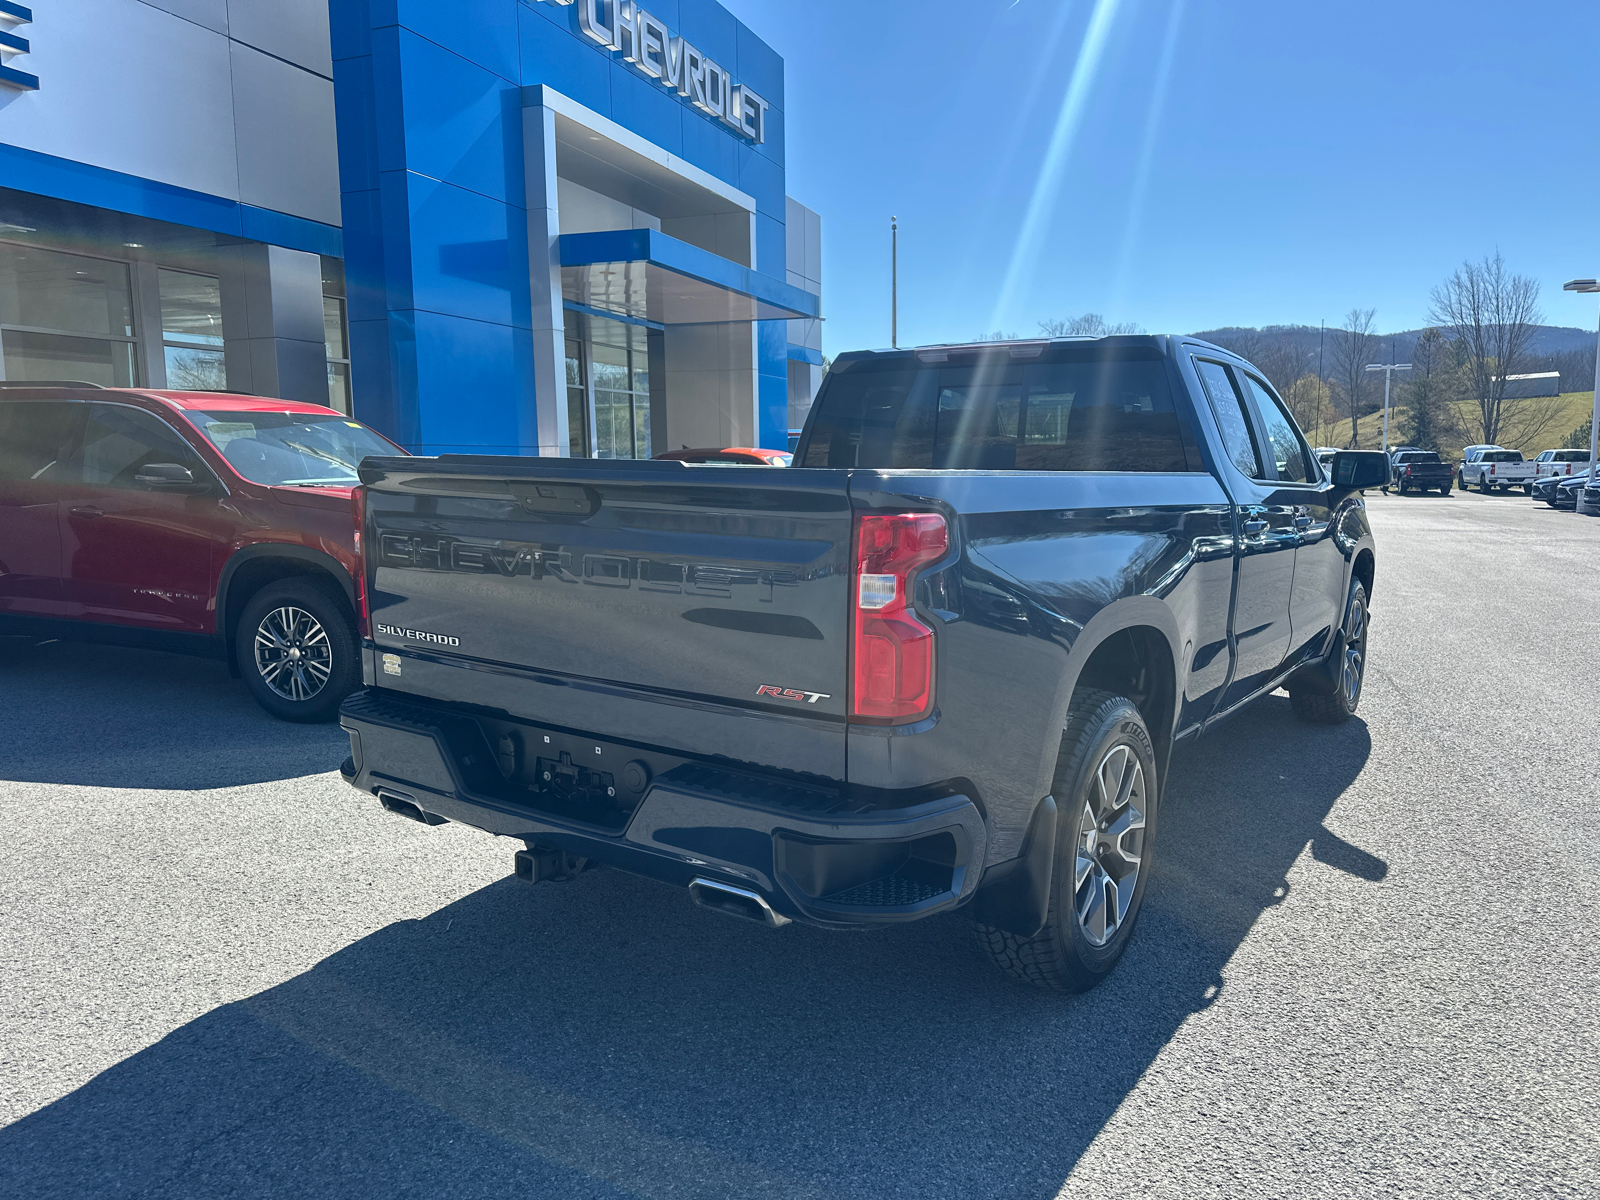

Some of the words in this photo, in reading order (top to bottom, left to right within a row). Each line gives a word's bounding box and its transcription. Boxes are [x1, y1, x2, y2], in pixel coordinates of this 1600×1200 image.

[578, 0, 768, 144] CHEVROLET
[380, 533, 798, 602] CHEVROLET
[377, 623, 461, 648] SILVERADO
[755, 683, 831, 704] RST
